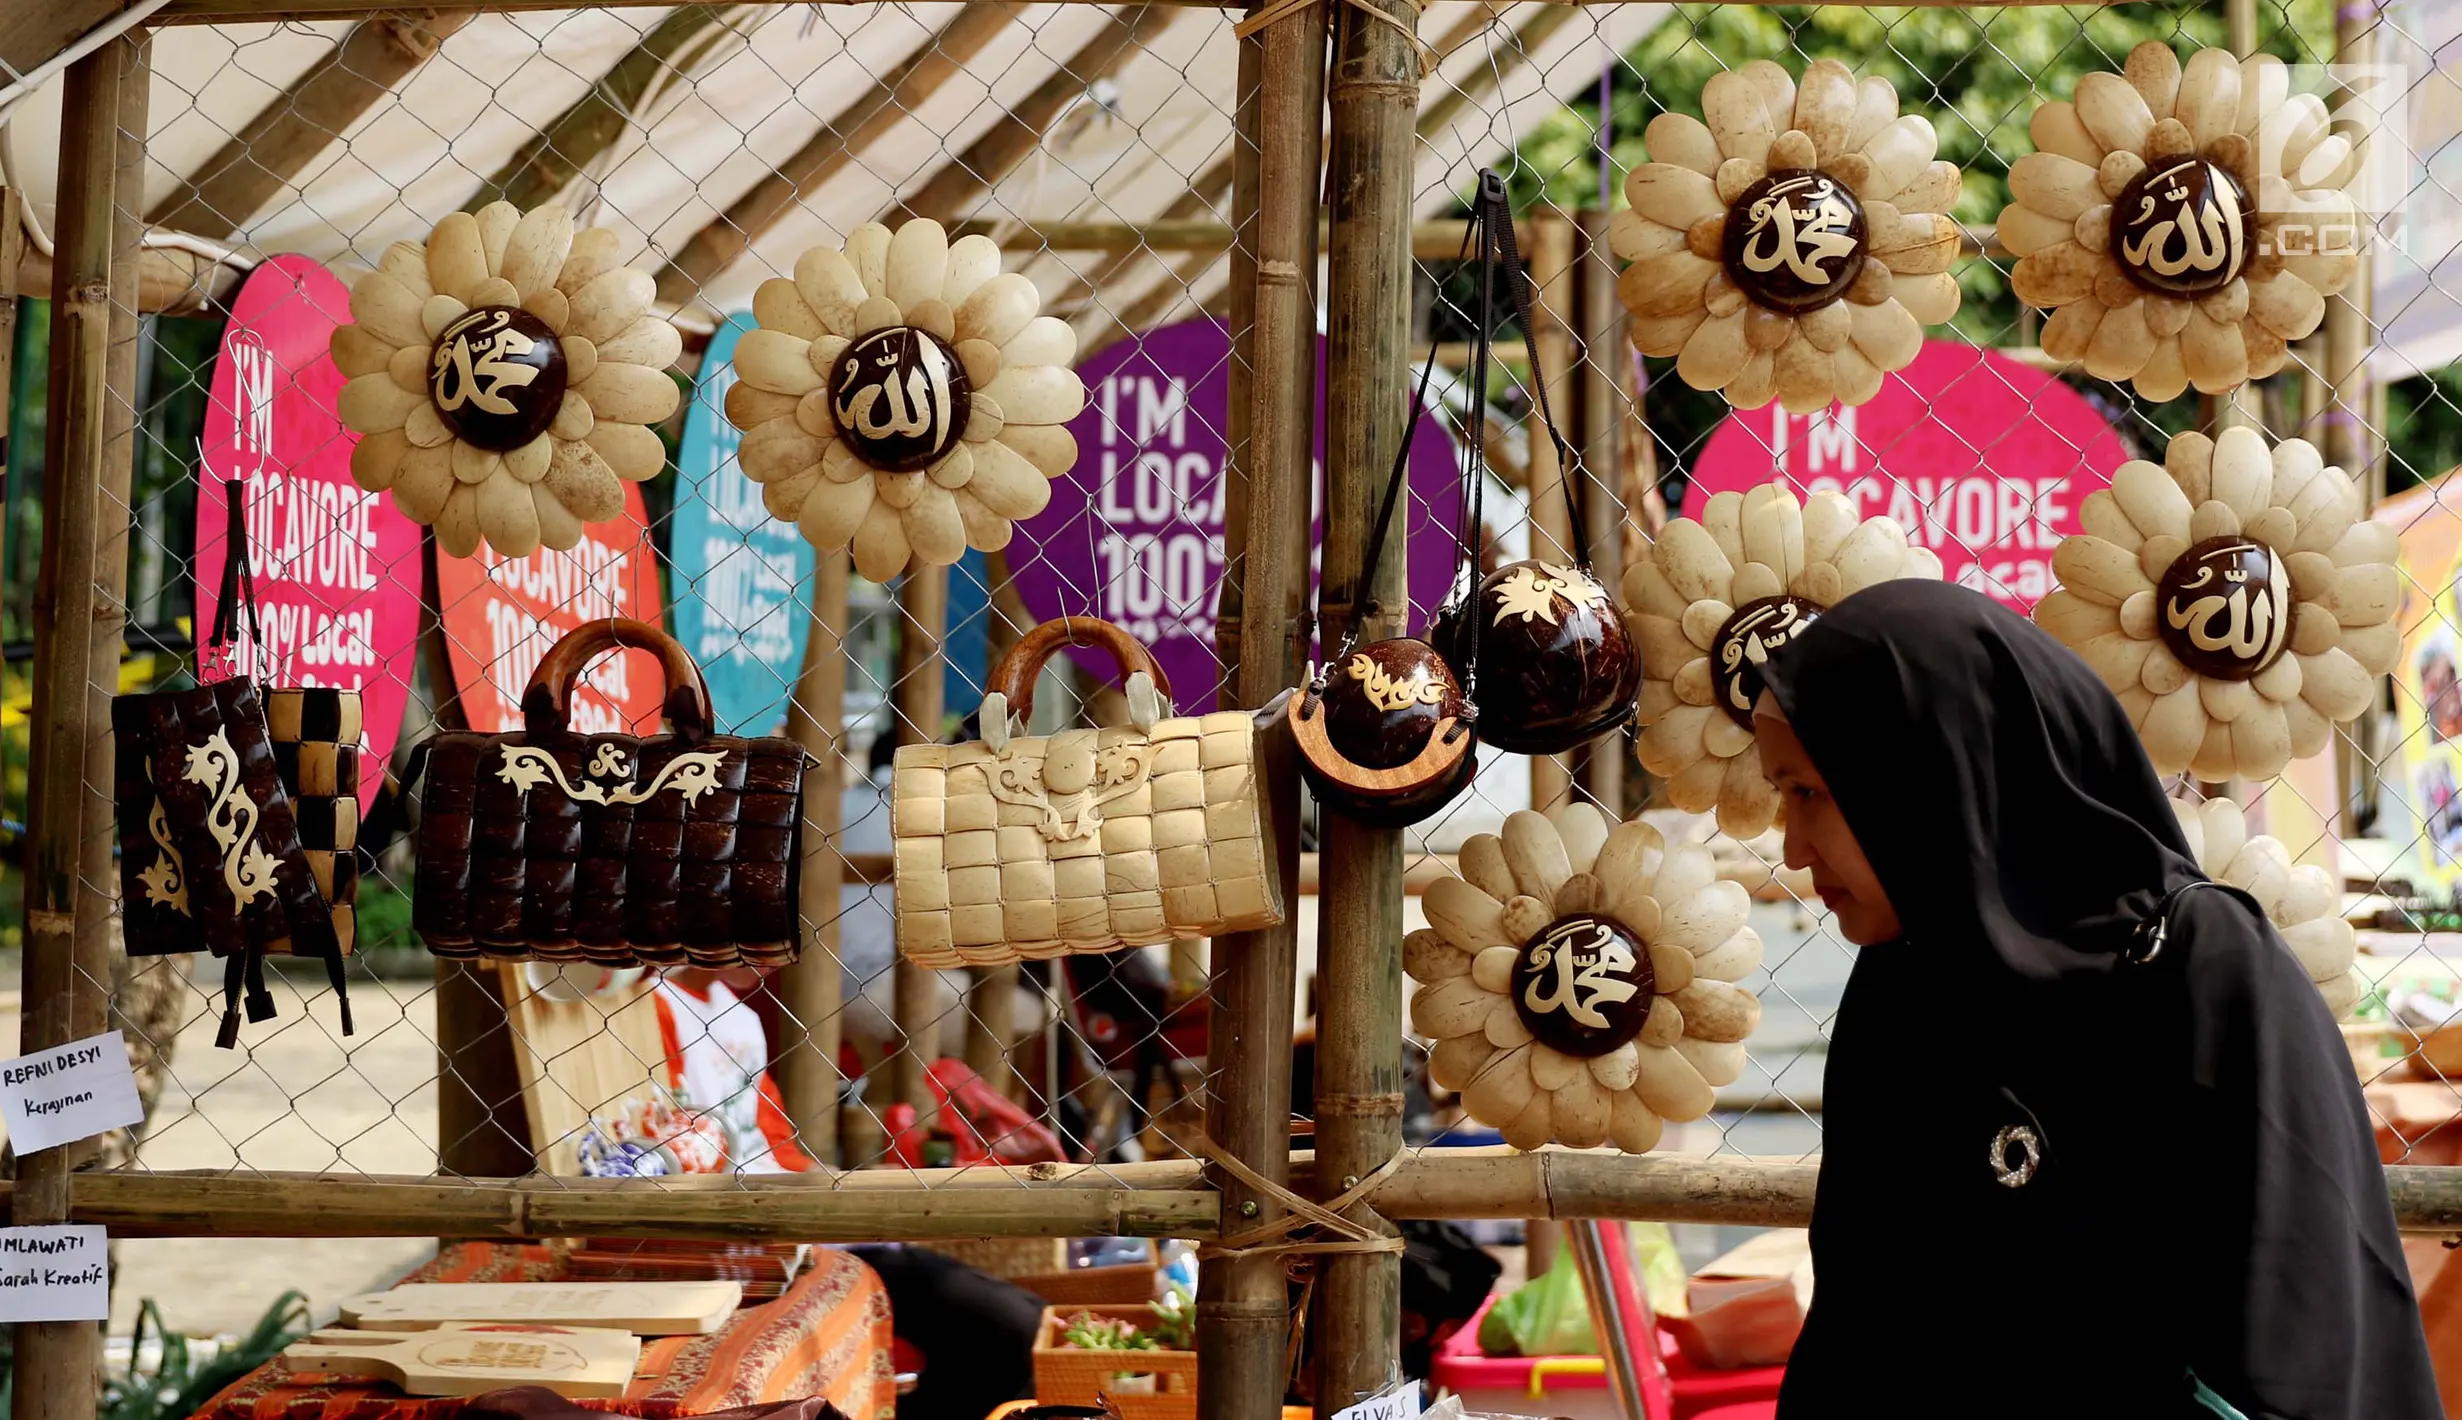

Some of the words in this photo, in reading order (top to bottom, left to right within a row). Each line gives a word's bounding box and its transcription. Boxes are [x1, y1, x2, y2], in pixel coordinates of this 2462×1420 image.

[234, 342, 274, 456] I'M
[1102, 376, 1187, 448] I'M
[234, 465, 380, 591] OCAVORE
[1773, 477, 2072, 549] CAVORE
[302, 604, 376, 667] Local
[3, 1060, 54, 1087] REFNI
[56, 1045, 101, 1071] DESYI
[0, 1236, 84, 1254] MLAWATI
[44, 1263, 103, 1286] Kreatif
